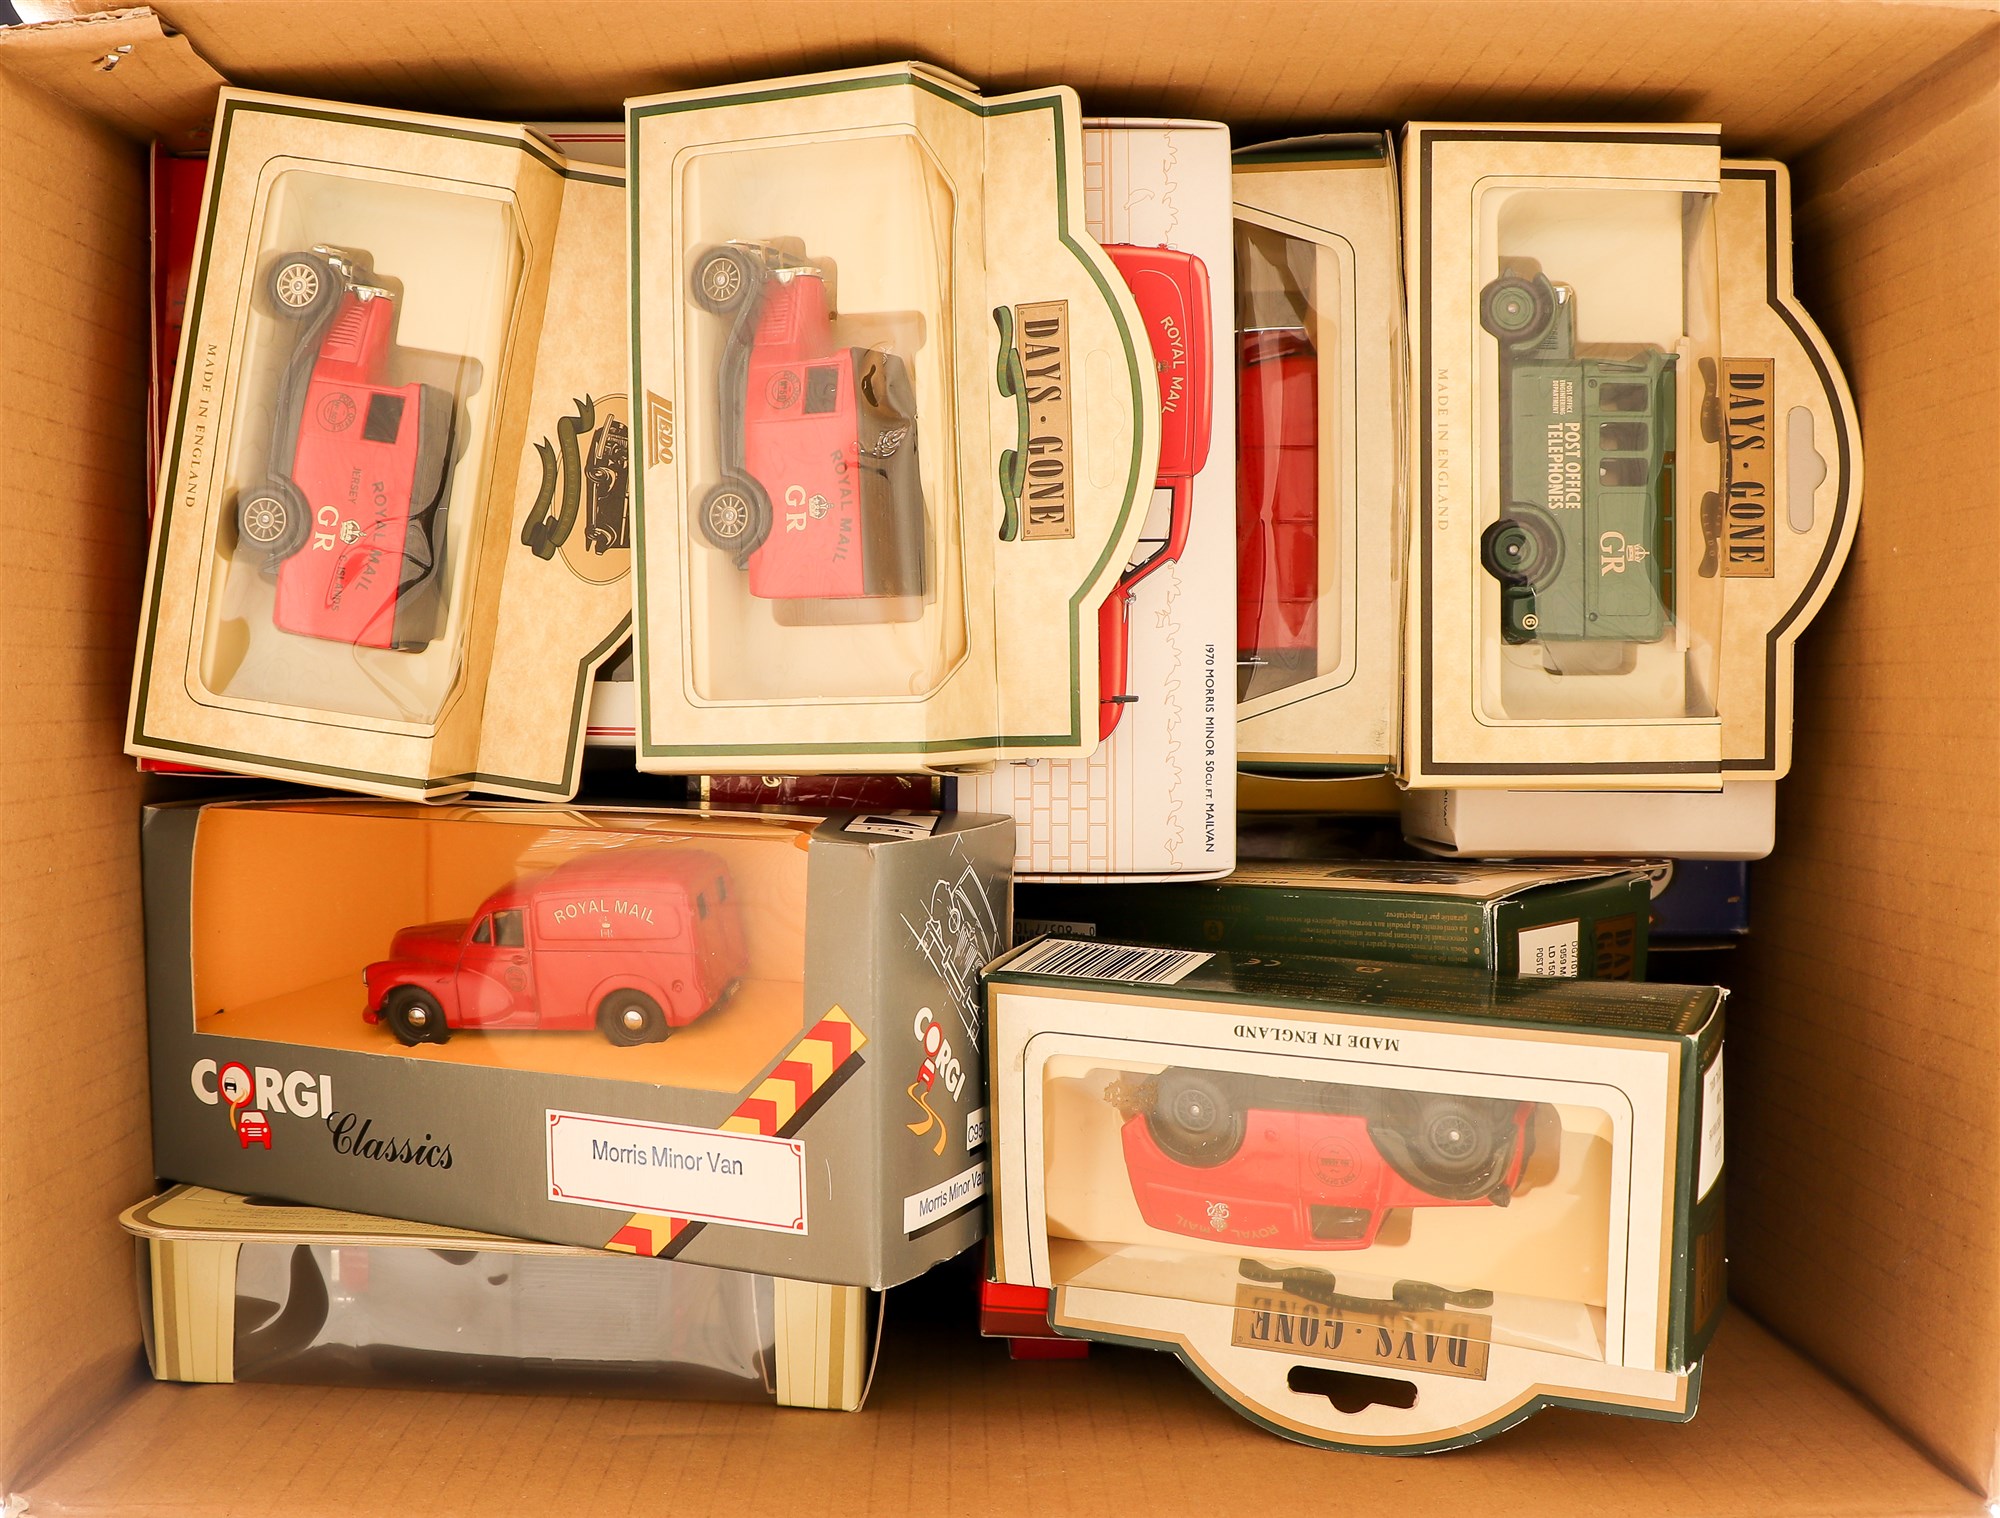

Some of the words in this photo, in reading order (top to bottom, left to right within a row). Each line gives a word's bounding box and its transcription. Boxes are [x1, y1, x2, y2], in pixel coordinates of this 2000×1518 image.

[1024, 317, 1063, 404] DAYS
[1160, 315, 1186, 369] ROYAL
[202, 344, 217, 393] MADE
[1437, 368, 1449, 416] MADE
[198, 399, 209, 418] IN
[1161, 376, 1185, 414] MAIL
[1728, 372, 1766, 450] DAYS
[1437, 423, 1449, 441] IN
[1565, 422, 1581, 458] POST
[185, 424, 206, 508] ENGLAND
[349, 466, 362, 504] JERSEY
[830, 448, 853, 512] ROYAL
[1027, 436, 1065, 525] GONE
[1547, 423, 1564, 510] TELEPHONES
[1565, 462, 1581, 510] OFFICE
[371, 481, 388, 542] ROYAL
[785, 484, 807, 533] GR
[1437, 449, 1449, 531] ENGLAND
[312, 505, 339, 551] GR
[832, 518, 853, 564] MAIL
[1729, 481, 1766, 563] GONE
[354, 550, 382, 592] MAIL
[1599, 531, 1626, 577] GR
[1205, 643, 1215, 666] 1970
[1205, 668, 1215, 713] MORRIS
[1205, 716, 1215, 757] MINOR
[1205, 802, 1215, 853] MAILVAN
[553, 899, 609, 925] ROYAL
[614, 900, 656, 926] MAIL
[1536, 947, 1544, 967] POST
[913, 1006, 967, 1103] CORGI
[1233, 1025, 1318, 1045] ENGLAND
[1323, 1033, 1343, 1047] IN
[1348, 1035, 1400, 1052] MADE
[191, 1058, 333, 1119] CORGI
[326, 1111, 454, 1170] Classics
[591, 1138, 648, 1168] Morris
[651, 1144, 703, 1173] Minor
[706, 1151, 744, 1177] Van
[919, 1191, 948, 1217] Morris
[948, 1179, 971, 1203] Minor
[971, 1170, 986, 1188] Van
[1175, 1213, 1210, 1234] MAIL
[1230, 1223, 1280, 1241] ROYAL
[1249, 1296, 1344, 1351] GONE
[1375, 1313, 1470, 1369] DAYS
